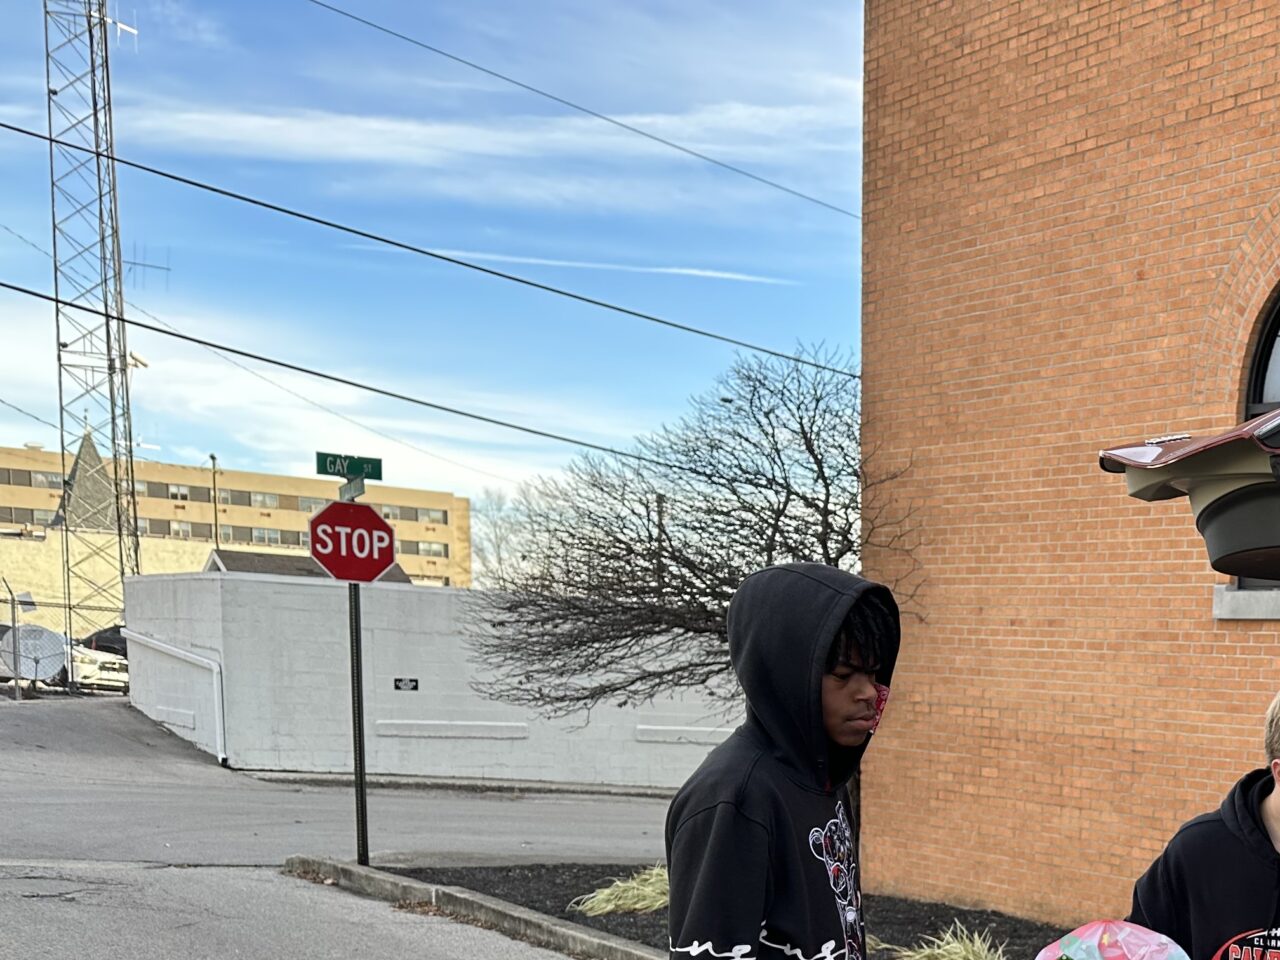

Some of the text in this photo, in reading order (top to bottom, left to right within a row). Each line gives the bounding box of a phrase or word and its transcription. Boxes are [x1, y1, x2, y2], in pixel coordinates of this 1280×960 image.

[326, 456, 372, 473] GAY ST
[315, 524, 390, 559] STOP
